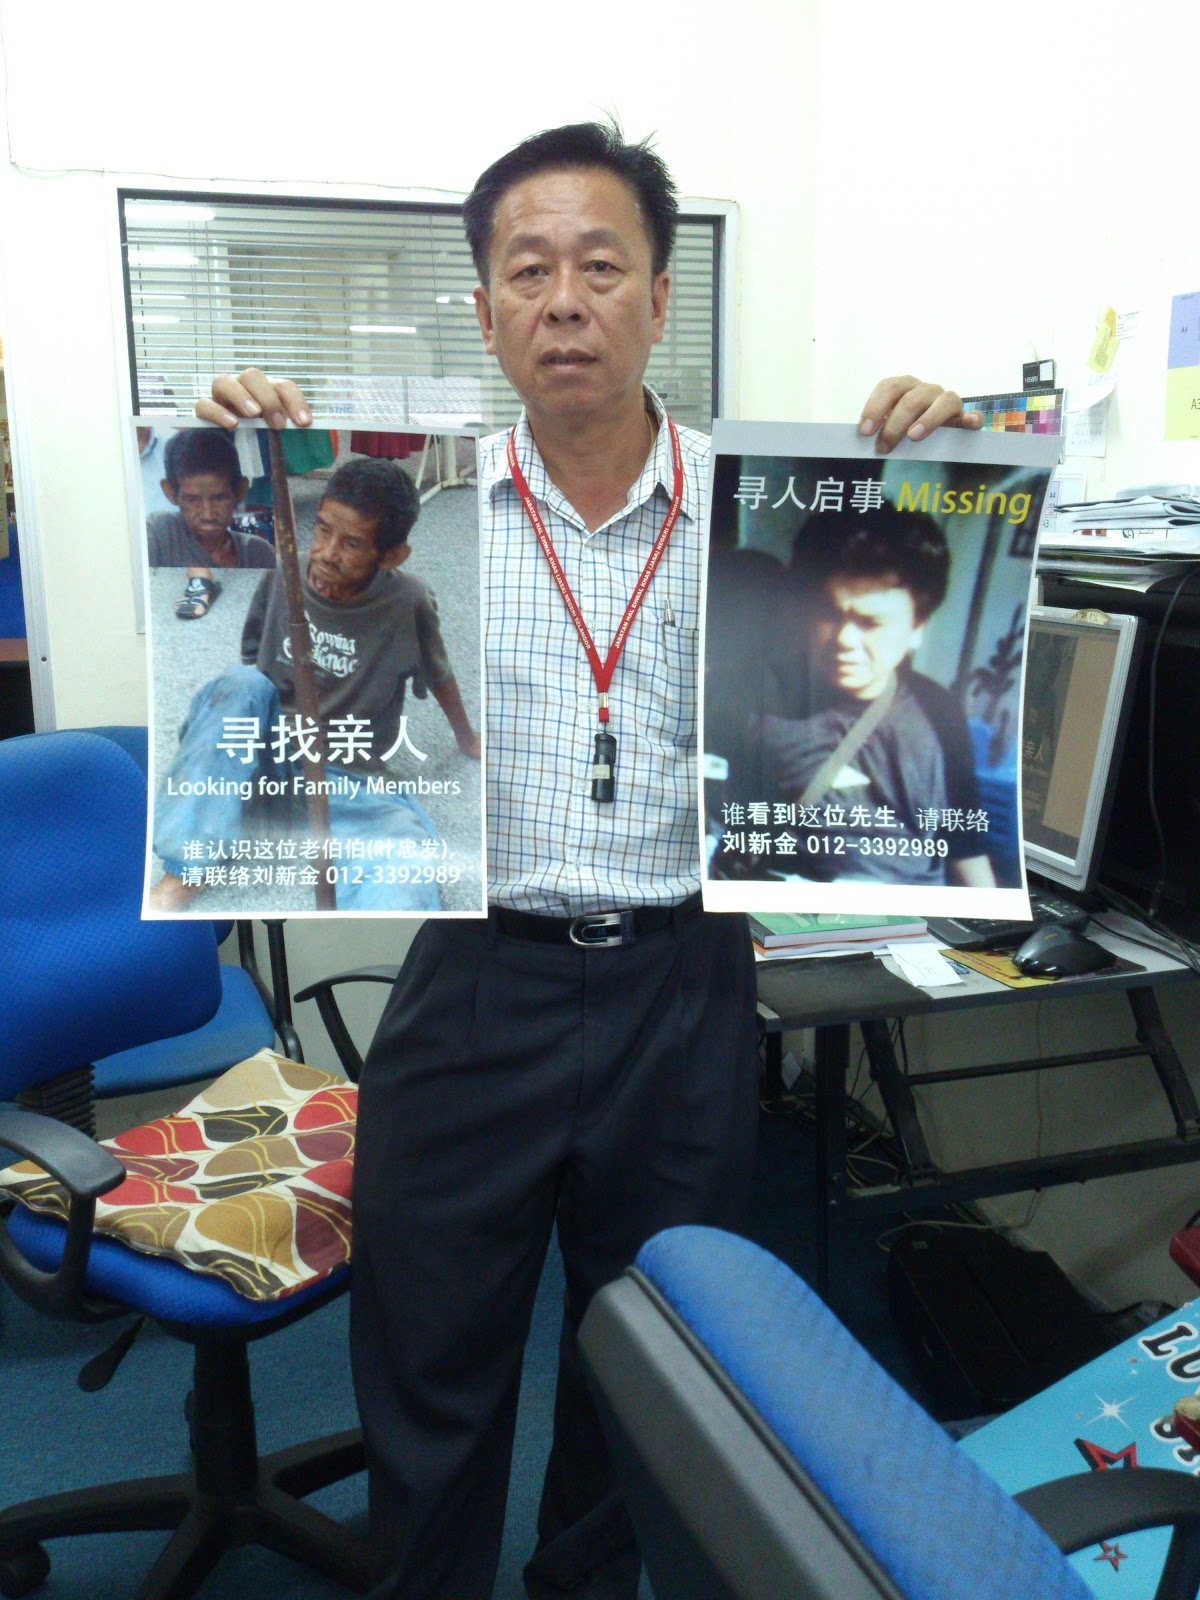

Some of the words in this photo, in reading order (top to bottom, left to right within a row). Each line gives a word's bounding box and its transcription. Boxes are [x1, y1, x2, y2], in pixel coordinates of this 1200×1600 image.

[733, 475, 887, 514] 寻人启事
[896, 481, 1032, 525] Missing
[524, 496, 539, 523] JABATAN
[574, 616, 591, 650] SELANGOR
[615, 621, 629, 649] JABATAN
[631, 587, 644, 610] EHWAL
[641, 570, 651, 587] KHAS
[656, 528, 670, 551] NEGERI
[666, 495, 680, 527] SELANGOR
[216, 714, 428, 765] 寻找亲人
[167, 776, 253, 799] Looking
[258, 775, 288, 795] for
[293, 776, 361, 800] Family
[366, 775, 461, 796] Members
[722, 830, 798, 856] 刘新金
[806, 835, 949, 858] 012-3392989
[180, 864, 321, 887] 请联络刘新金
[325, 866, 461, 885] 012-3392989
